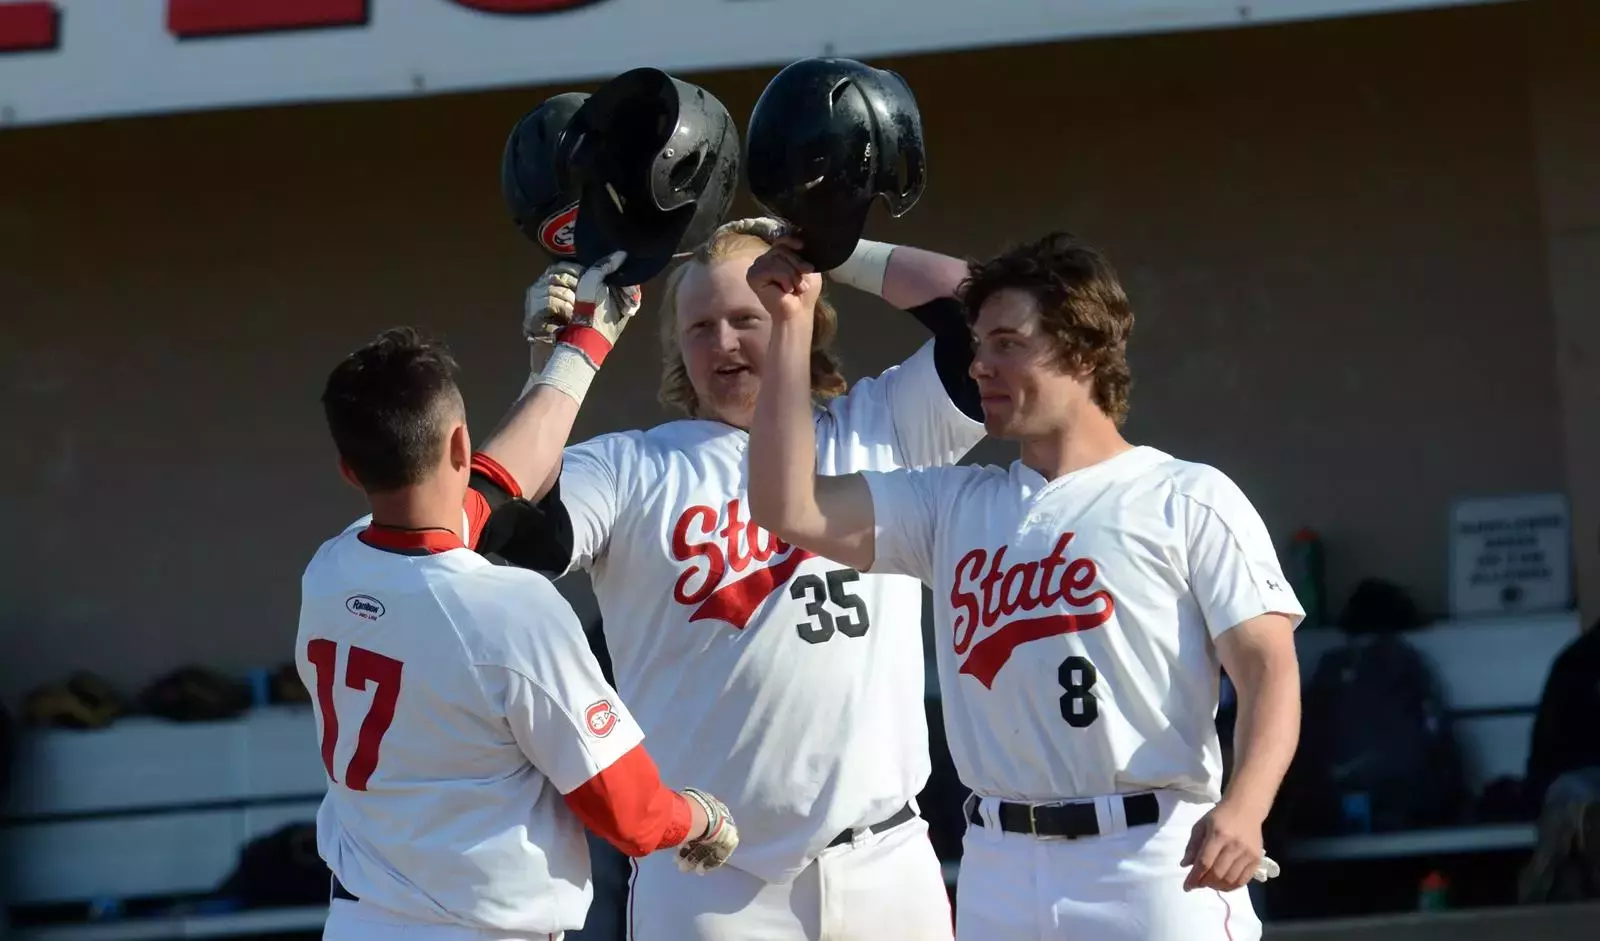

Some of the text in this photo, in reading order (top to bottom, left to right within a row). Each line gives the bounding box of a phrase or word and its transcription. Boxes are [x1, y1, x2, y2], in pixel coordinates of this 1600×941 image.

[672, 498, 792, 606] Sta
[789, 568, 870, 644] 35
[951, 532, 1114, 655] State
[307, 638, 404, 791] 17
[1058, 656, 1099, 728] 8
